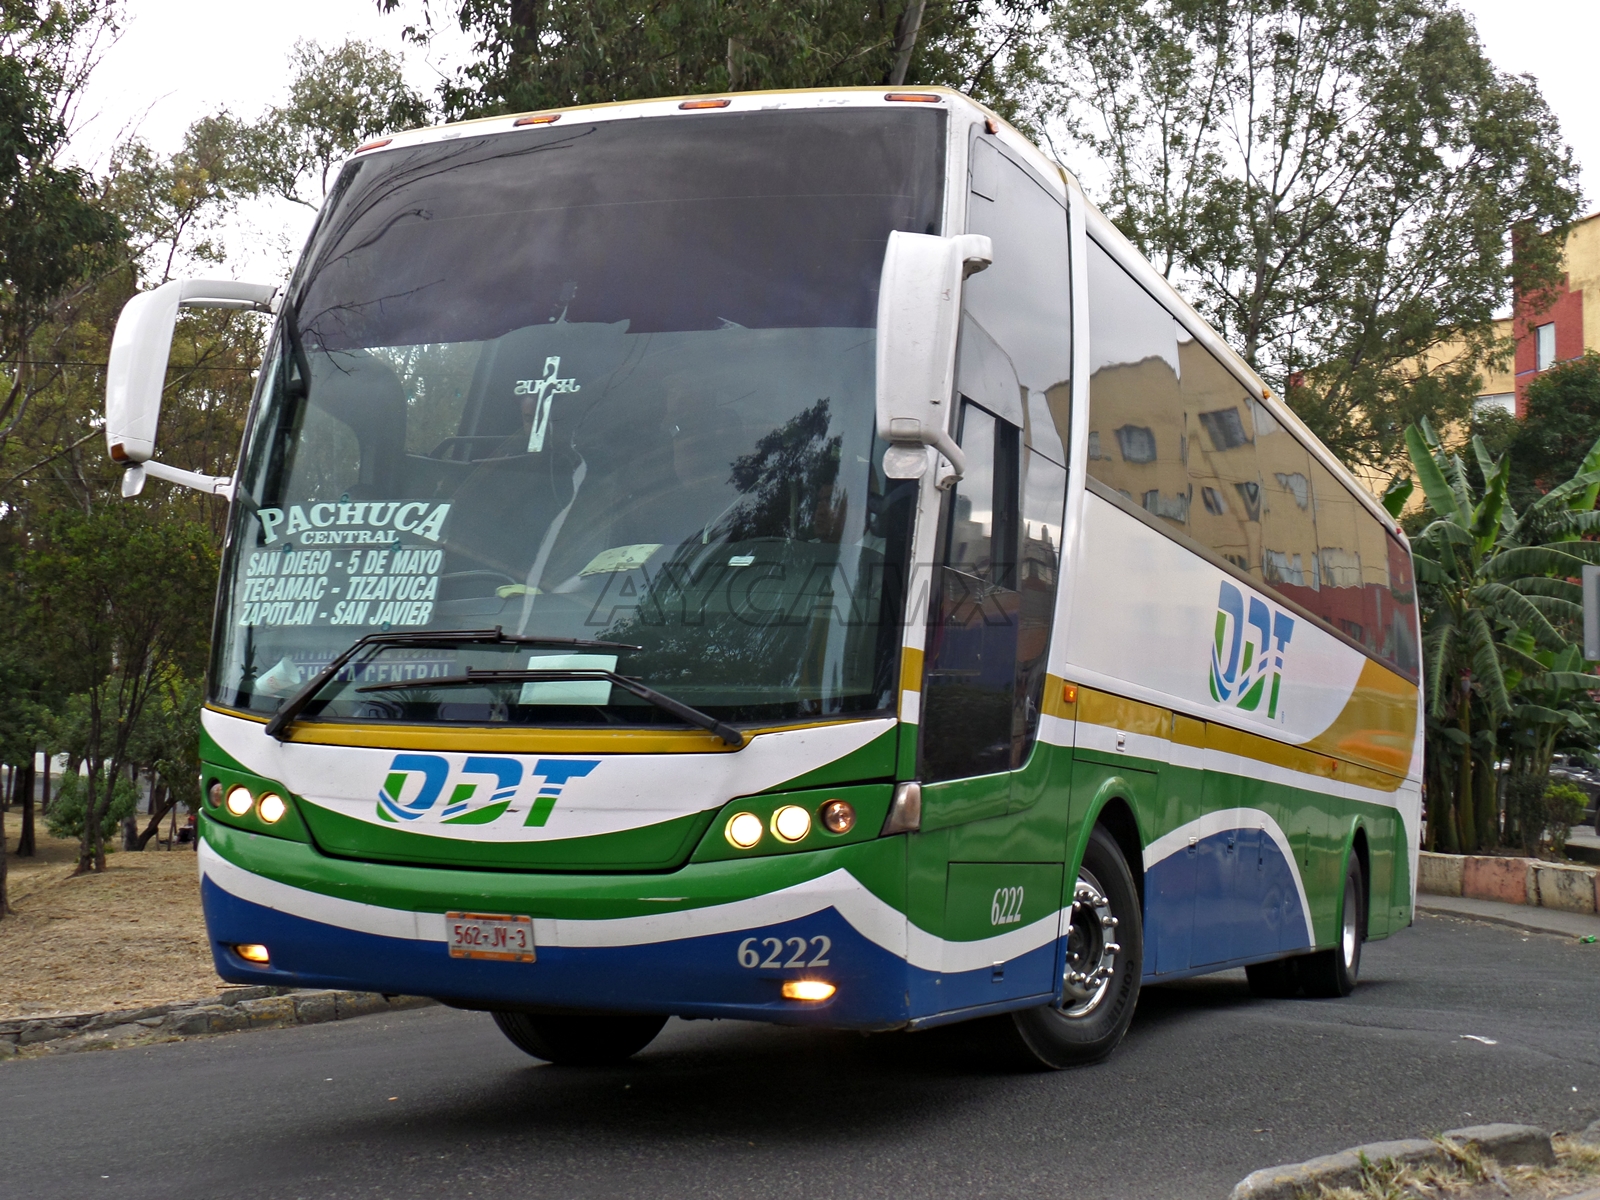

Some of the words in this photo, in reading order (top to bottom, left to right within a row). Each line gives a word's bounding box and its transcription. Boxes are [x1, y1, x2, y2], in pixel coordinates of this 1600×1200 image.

[257, 502, 451, 545] PACHUCA
[300, 530, 399, 545] CENTRAL
[246, 551, 282, 577] SAN
[281, 550, 332, 576] DIEGO
[347, 550, 362, 575] 5
[363, 550, 389, 575] DE
[389, 549, 443, 575] MAYO
[242, 576, 328, 602] TECAMAC
[346, 576, 439, 600] TIZAYUCA
[239, 601, 318, 626] ZAPOTLAN
[330, 601, 370, 625] SAN
[369, 601, 434, 625] JAVIER
[990, 885, 1025, 926] 6222
[454, 923, 527, 949] 562-JV-3
[737, 935, 832, 969] 6222
